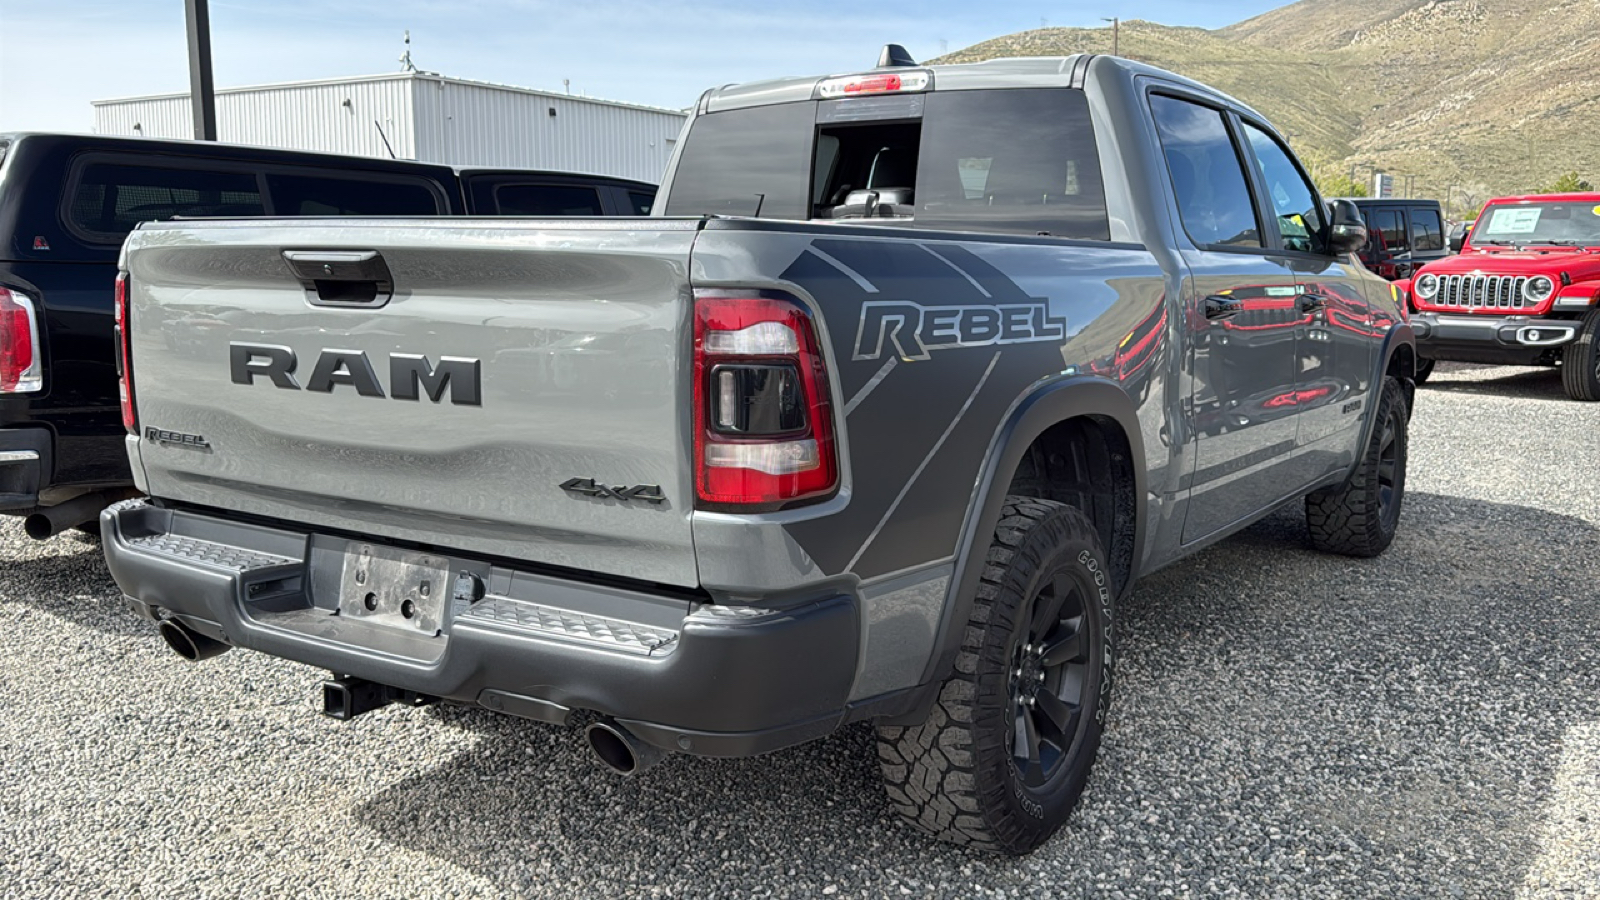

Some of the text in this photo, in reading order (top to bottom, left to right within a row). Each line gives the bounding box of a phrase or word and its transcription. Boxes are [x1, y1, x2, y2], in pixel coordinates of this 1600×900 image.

[852, 300, 1063, 361] REBEL
[230, 341, 482, 407] RAM
[145, 426, 210, 448] REBEL
[1078, 550, 1112, 725] GOODYEAR
